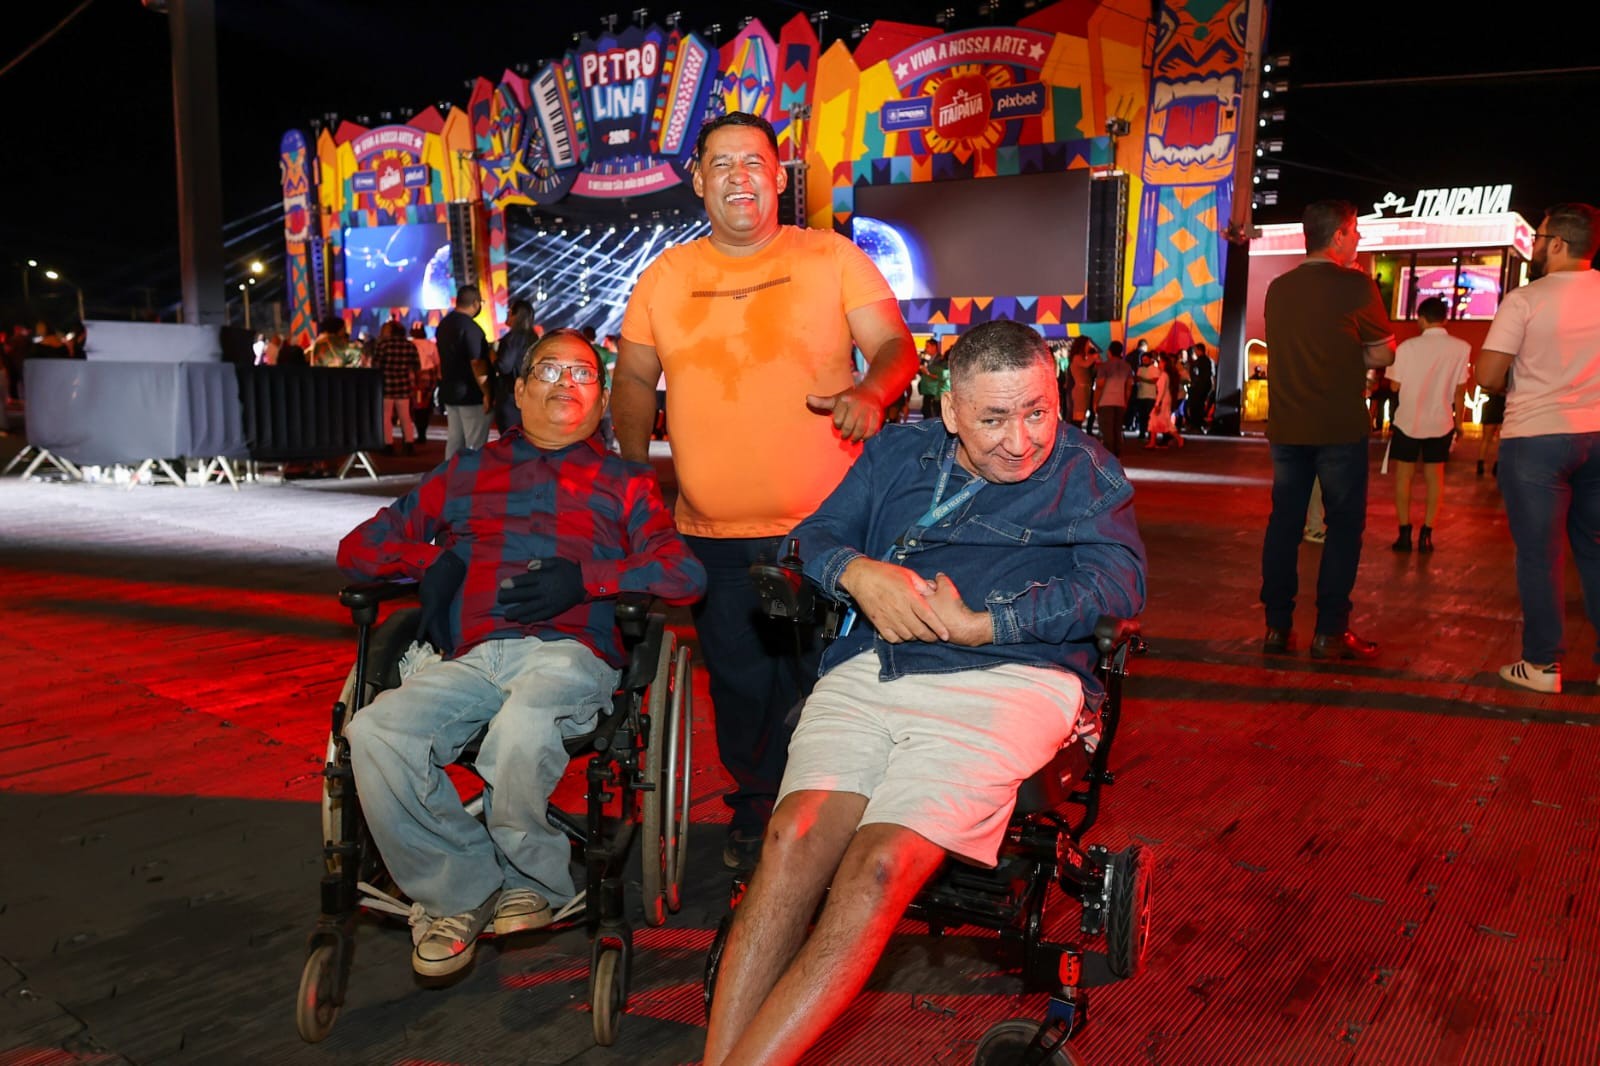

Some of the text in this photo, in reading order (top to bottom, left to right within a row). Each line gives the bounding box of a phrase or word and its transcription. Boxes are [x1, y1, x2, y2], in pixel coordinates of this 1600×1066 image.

[582, 43, 657, 88] PETRO
[909, 35, 1028, 71] VIVA A NOSSA ARTE
[593, 79, 647, 119] LINA
[939, 97, 983, 127] ITAIPAVA
[1411, 184, 1512, 218] ITAIPAVA
[947, 491, 971, 509] TELECOM
